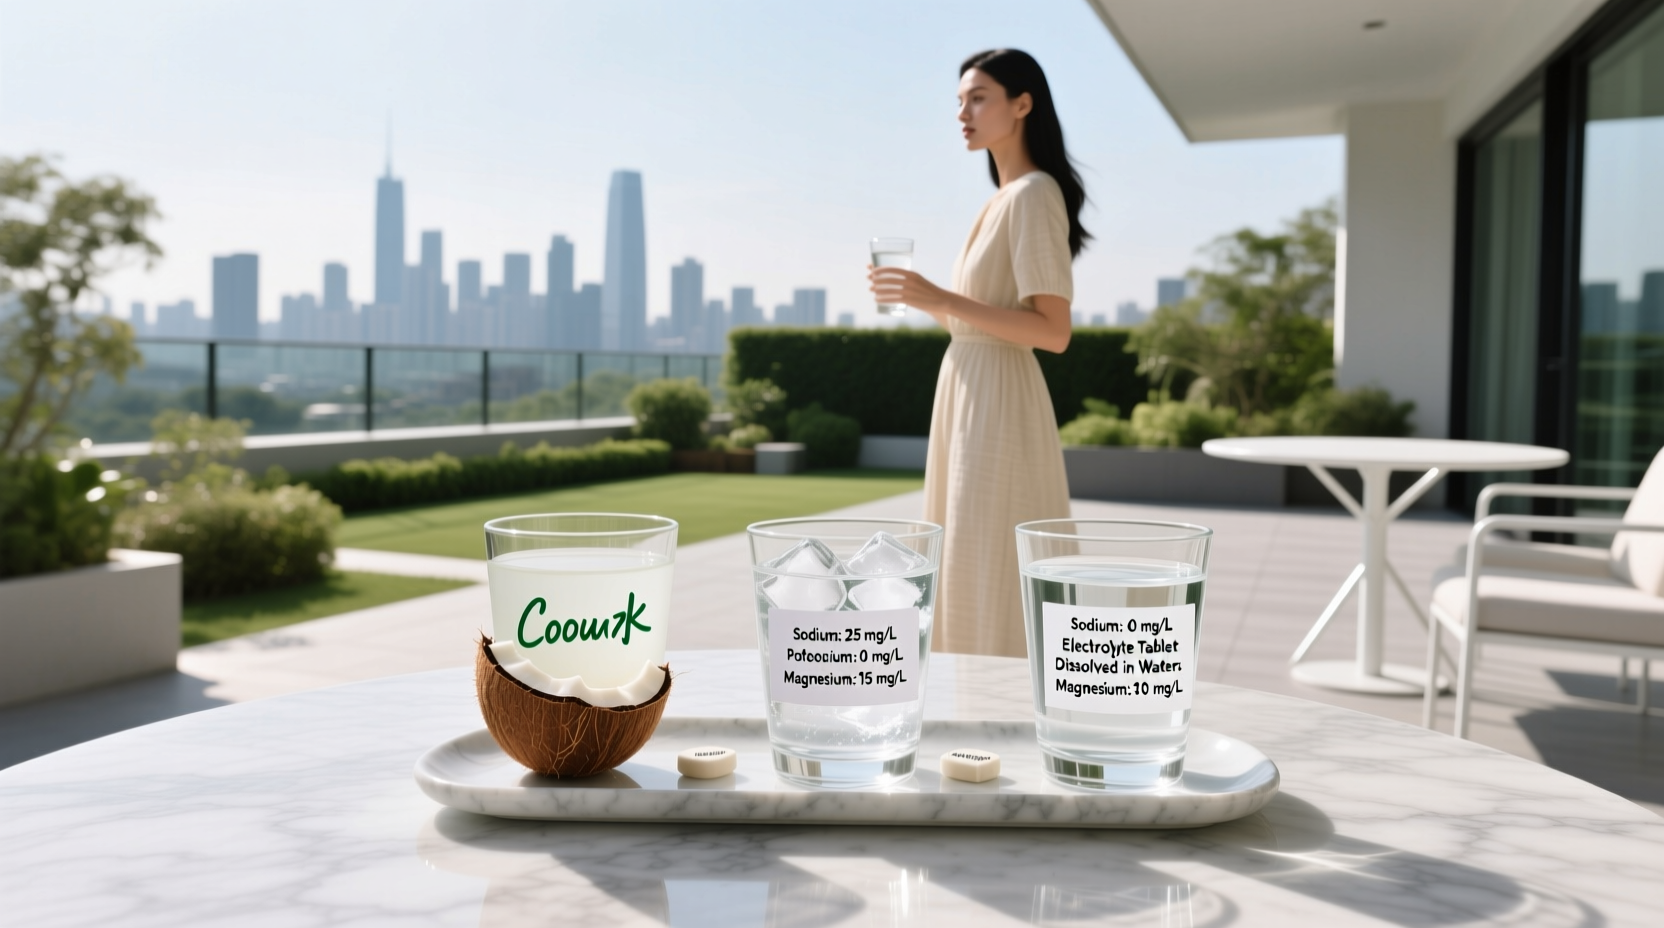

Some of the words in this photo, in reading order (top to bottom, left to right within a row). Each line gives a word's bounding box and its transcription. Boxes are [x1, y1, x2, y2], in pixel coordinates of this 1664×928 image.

[793, 627, 842, 642] Sodium:
[844, 628, 862, 642] 25
[864, 626, 898, 645] mg/L
[1070, 617, 1124, 633] Sodium:
[1127, 618, 1137, 633] 0
[1140, 616, 1173, 636] mg/L
[1137, 638, 1180, 655] Tablet
[859, 649, 869, 663] 0
[872, 647, 904, 666] mg/L
[1123, 660, 1135, 675] in
[784, 670, 857, 689] Magnesium:
[858, 671, 873, 686] 15
[876, 669, 908, 688] mg/L
[1055, 679, 1132, 698] Magnesium:
[1153, 679, 1184, 699] mg/L
